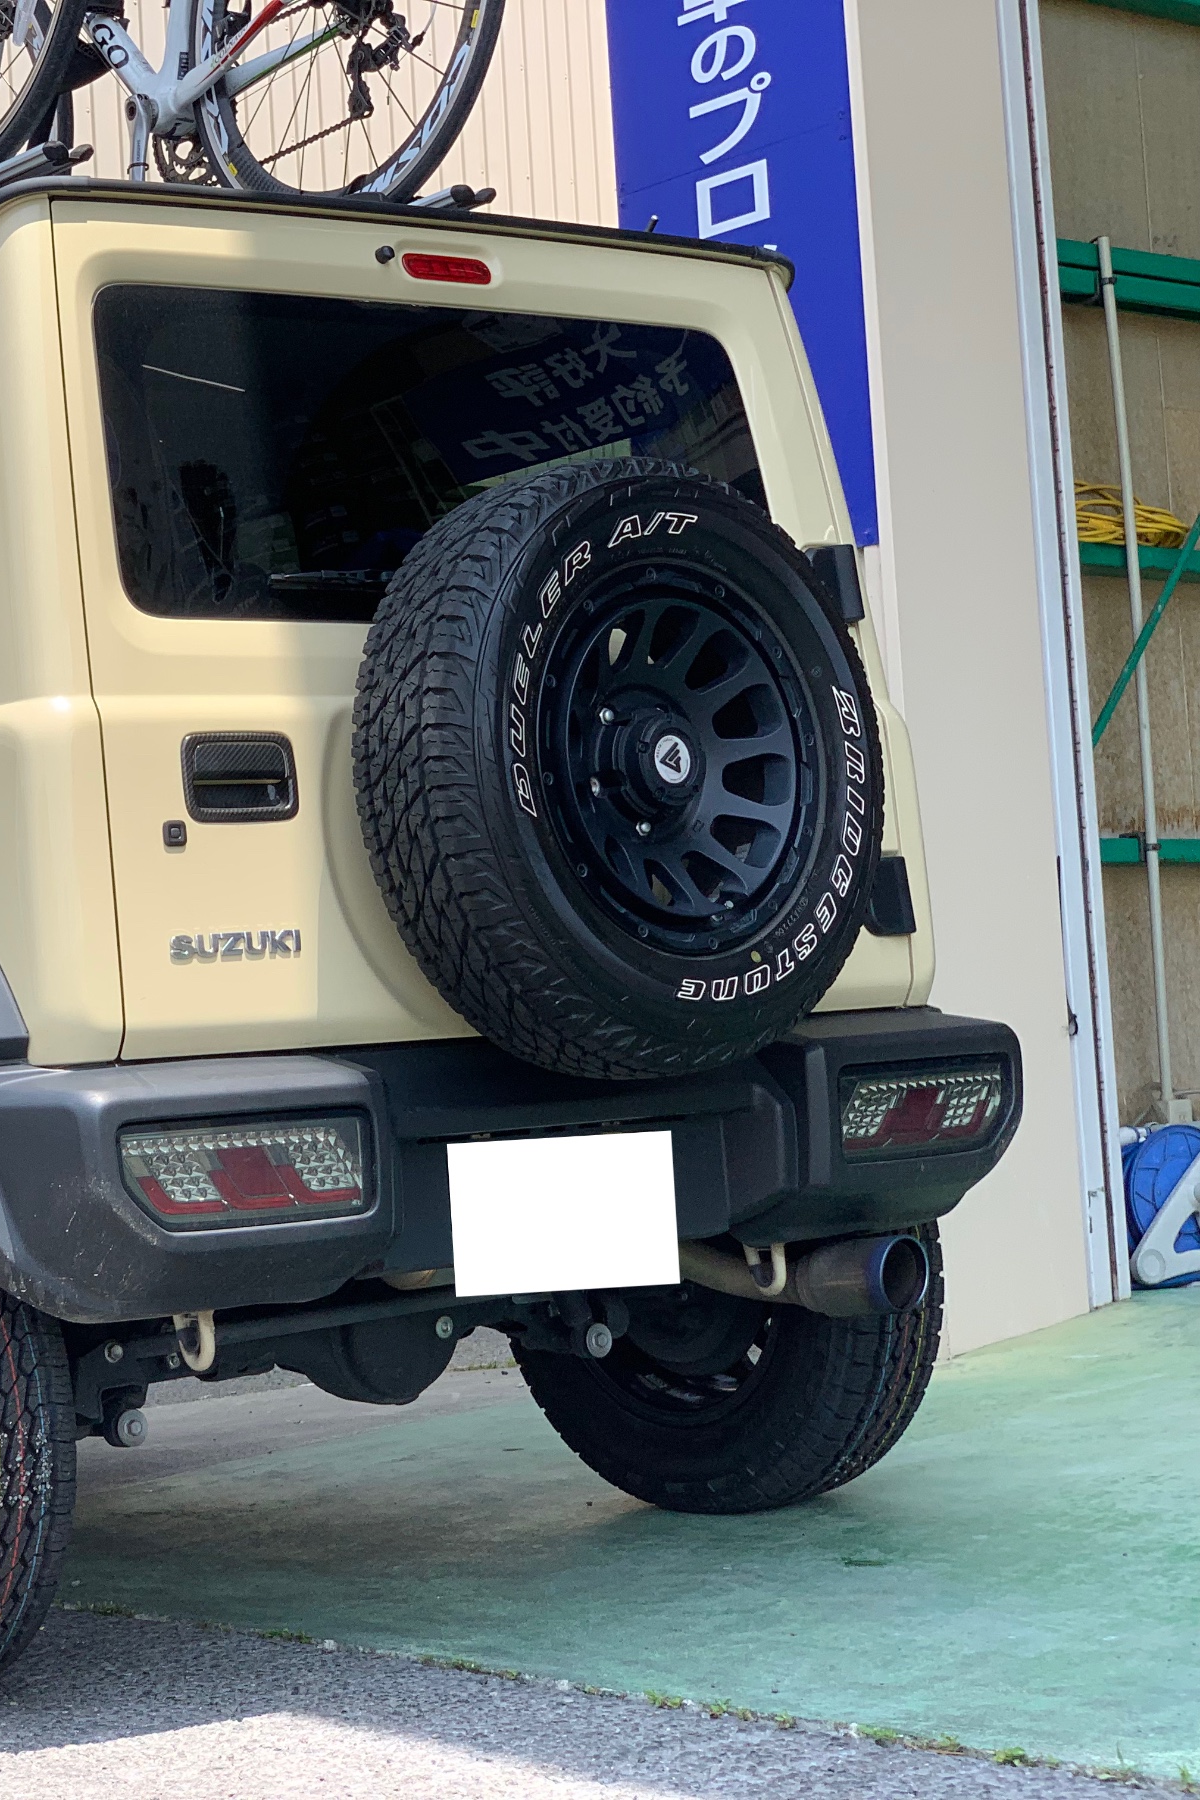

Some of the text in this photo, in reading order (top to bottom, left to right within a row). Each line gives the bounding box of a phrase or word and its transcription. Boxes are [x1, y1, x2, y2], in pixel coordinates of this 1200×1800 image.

[676, 0, 779, 252] のプロ
[513, 539, 595, 818] DUELER
[607, 510, 699, 550] A/T
[169, 929, 302, 961] SUZUKI
[677, 684, 864, 1001] BRIDGESTONE
